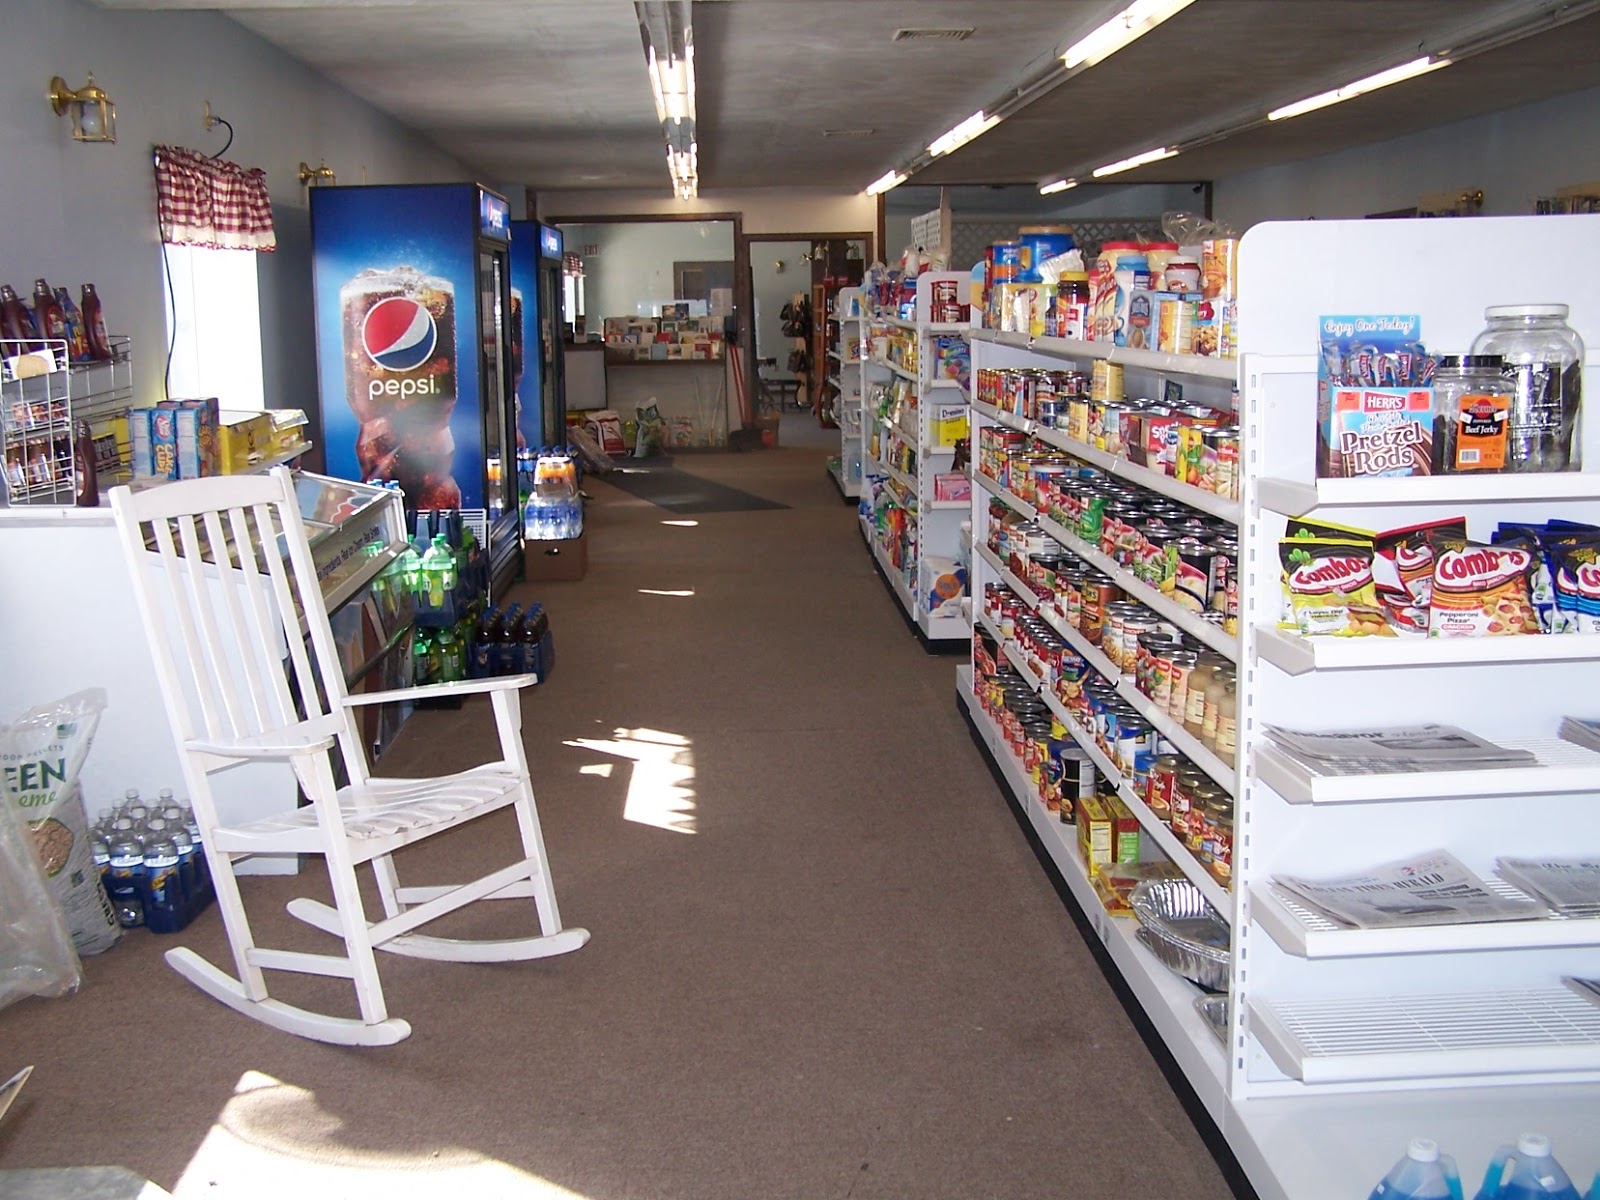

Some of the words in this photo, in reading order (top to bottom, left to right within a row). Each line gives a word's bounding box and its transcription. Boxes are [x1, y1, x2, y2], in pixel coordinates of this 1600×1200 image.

[1325, 320, 1353, 336] Enjoy
[1356, 319, 1376, 331] One
[1378, 317, 1415, 334] Today!
[369, 374, 434, 400] pepsi
[1367, 396, 1402, 409] HERR'S
[1341, 421, 1421, 453] Pretzel
[1465, 425, 1479, 433] Beef
[1480, 425, 1499, 435] Jerky
[1355, 446, 1413, 474] Rods
[1294, 556, 1369, 585] Combos
[1439, 549, 1525, 580] Combs
[1439, 612, 1479, 622] Pepperoni
[4, 757, 67, 793] EEN
[19, 791, 58, 808] eme
